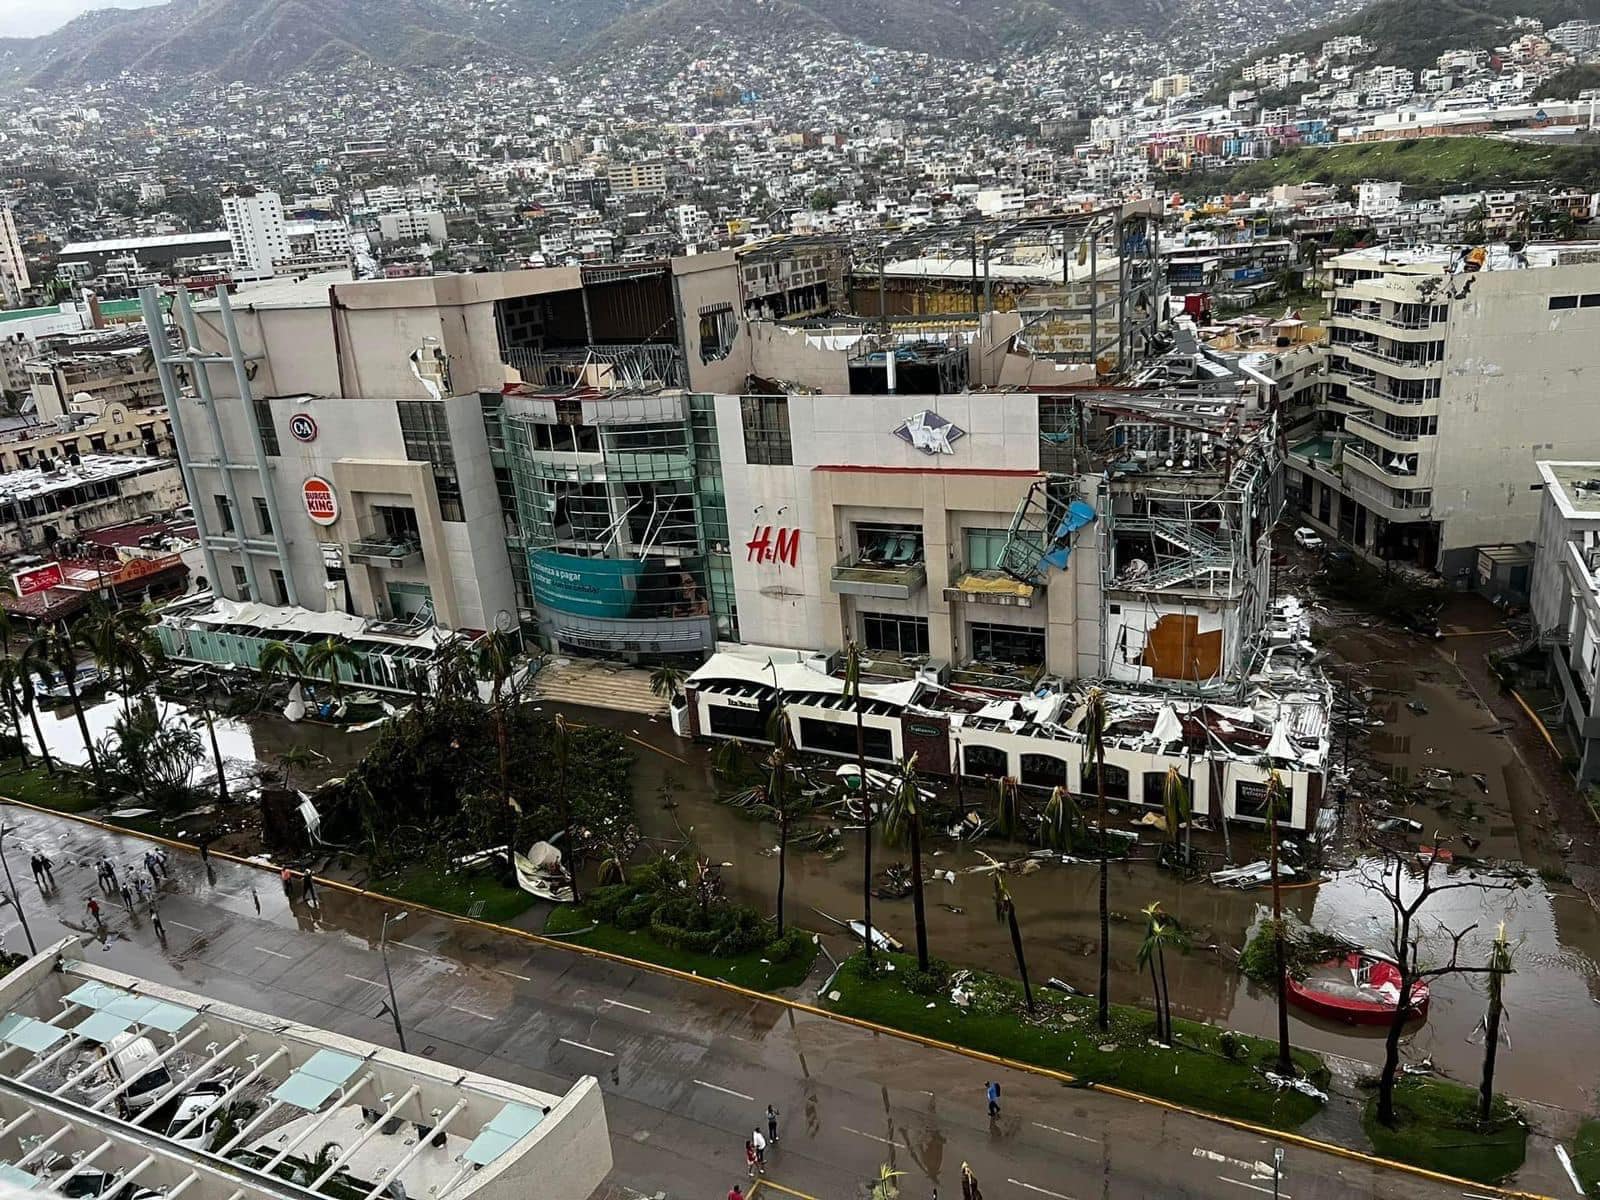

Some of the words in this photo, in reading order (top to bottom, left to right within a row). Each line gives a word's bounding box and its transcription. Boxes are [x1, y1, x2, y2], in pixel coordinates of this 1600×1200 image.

[305, 492, 331, 500] BURGER
[307, 500, 333, 511] KING
[746, 526, 801, 568] H&M
[560, 570, 581, 582] pagar
